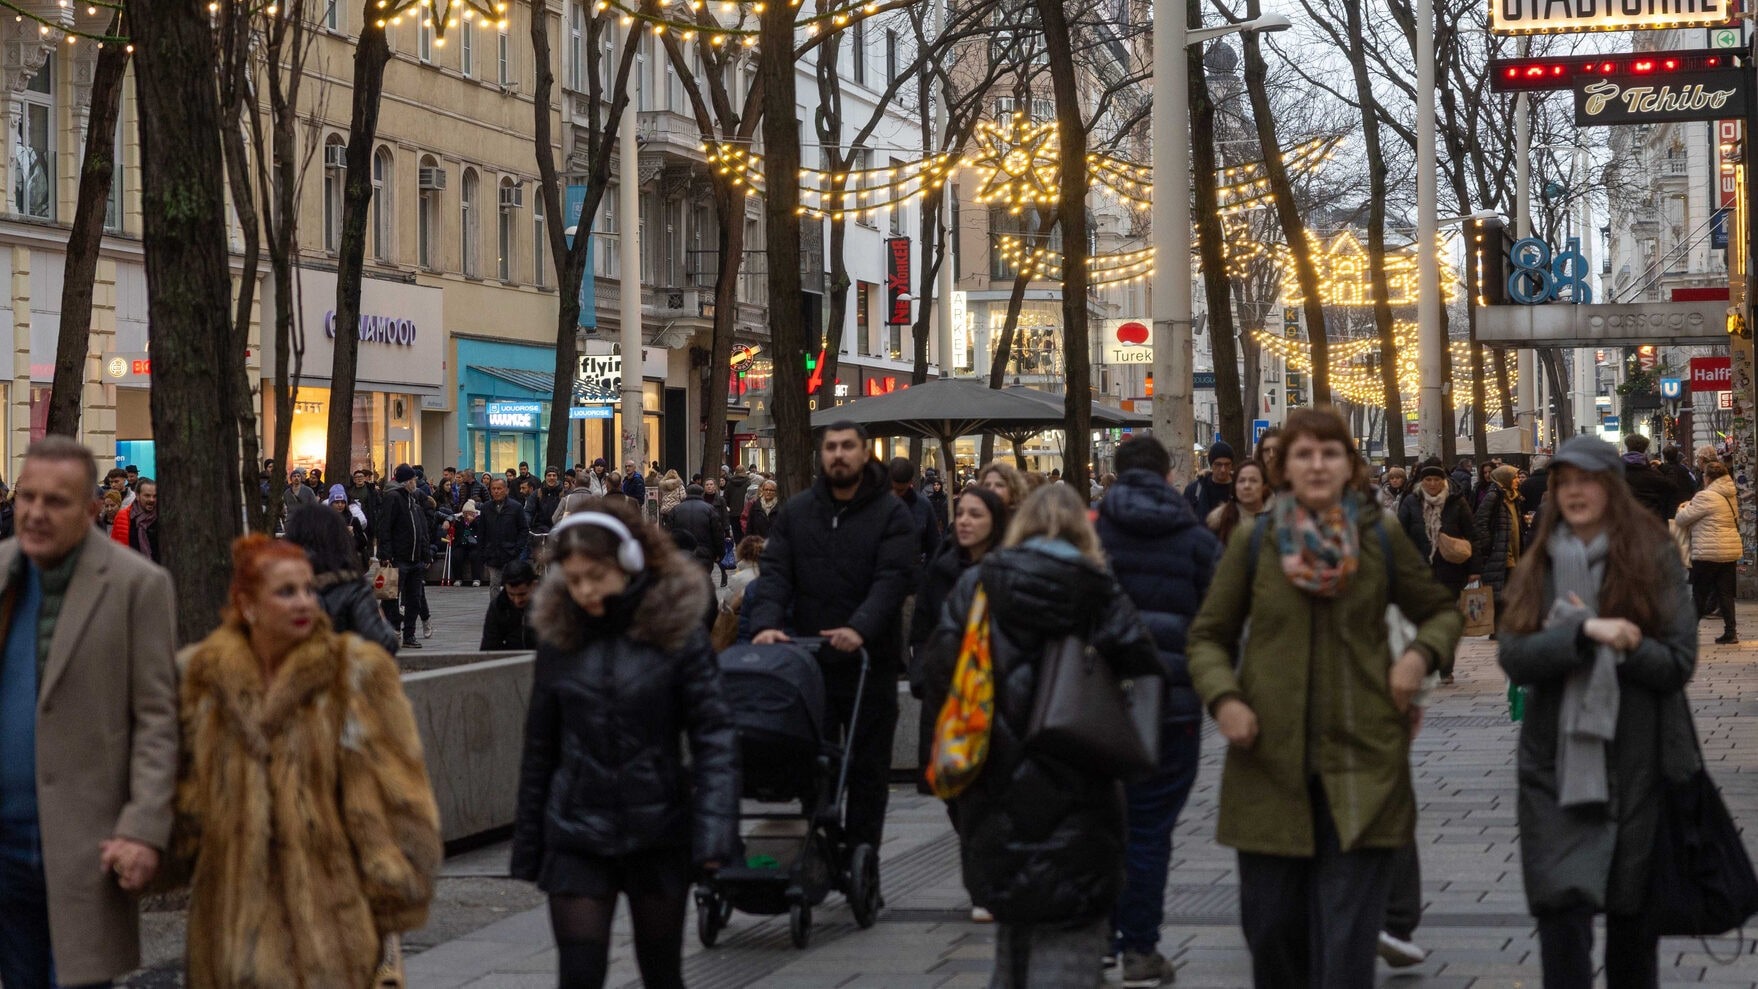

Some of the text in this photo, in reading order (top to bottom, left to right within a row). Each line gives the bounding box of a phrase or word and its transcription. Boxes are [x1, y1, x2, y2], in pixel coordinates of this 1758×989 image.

[1621, 84, 1737, 113] Tchibo
[953, 293, 963, 365] ARKET
[1588, 312, 1705, 329] passage
[1113, 350, 1152, 362] Turek
[1664, 382, 1678, 396] U
